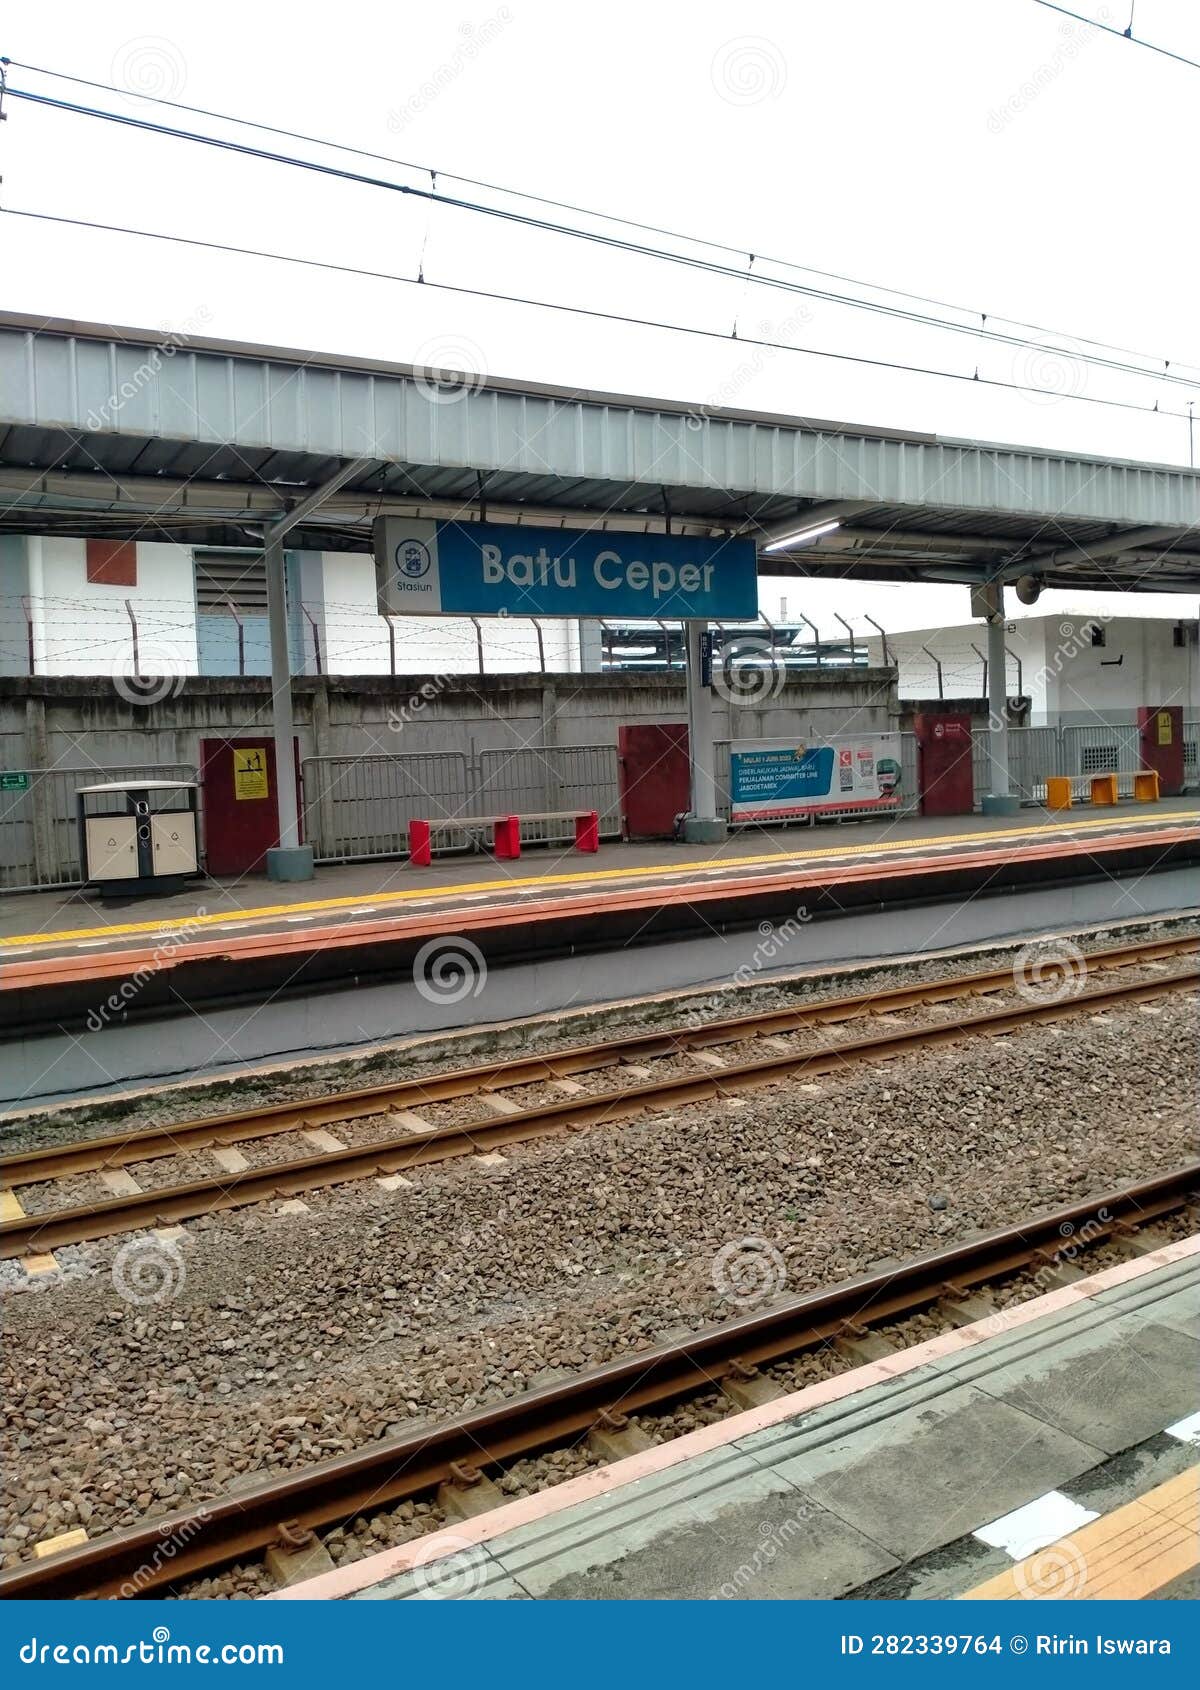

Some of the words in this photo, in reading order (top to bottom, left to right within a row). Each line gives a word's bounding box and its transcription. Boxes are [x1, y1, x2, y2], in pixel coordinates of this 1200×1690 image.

[396, 581, 433, 592] Stasiun
[481, 543, 577, 588] Batu
[593, 550, 715, 599] Ceper
